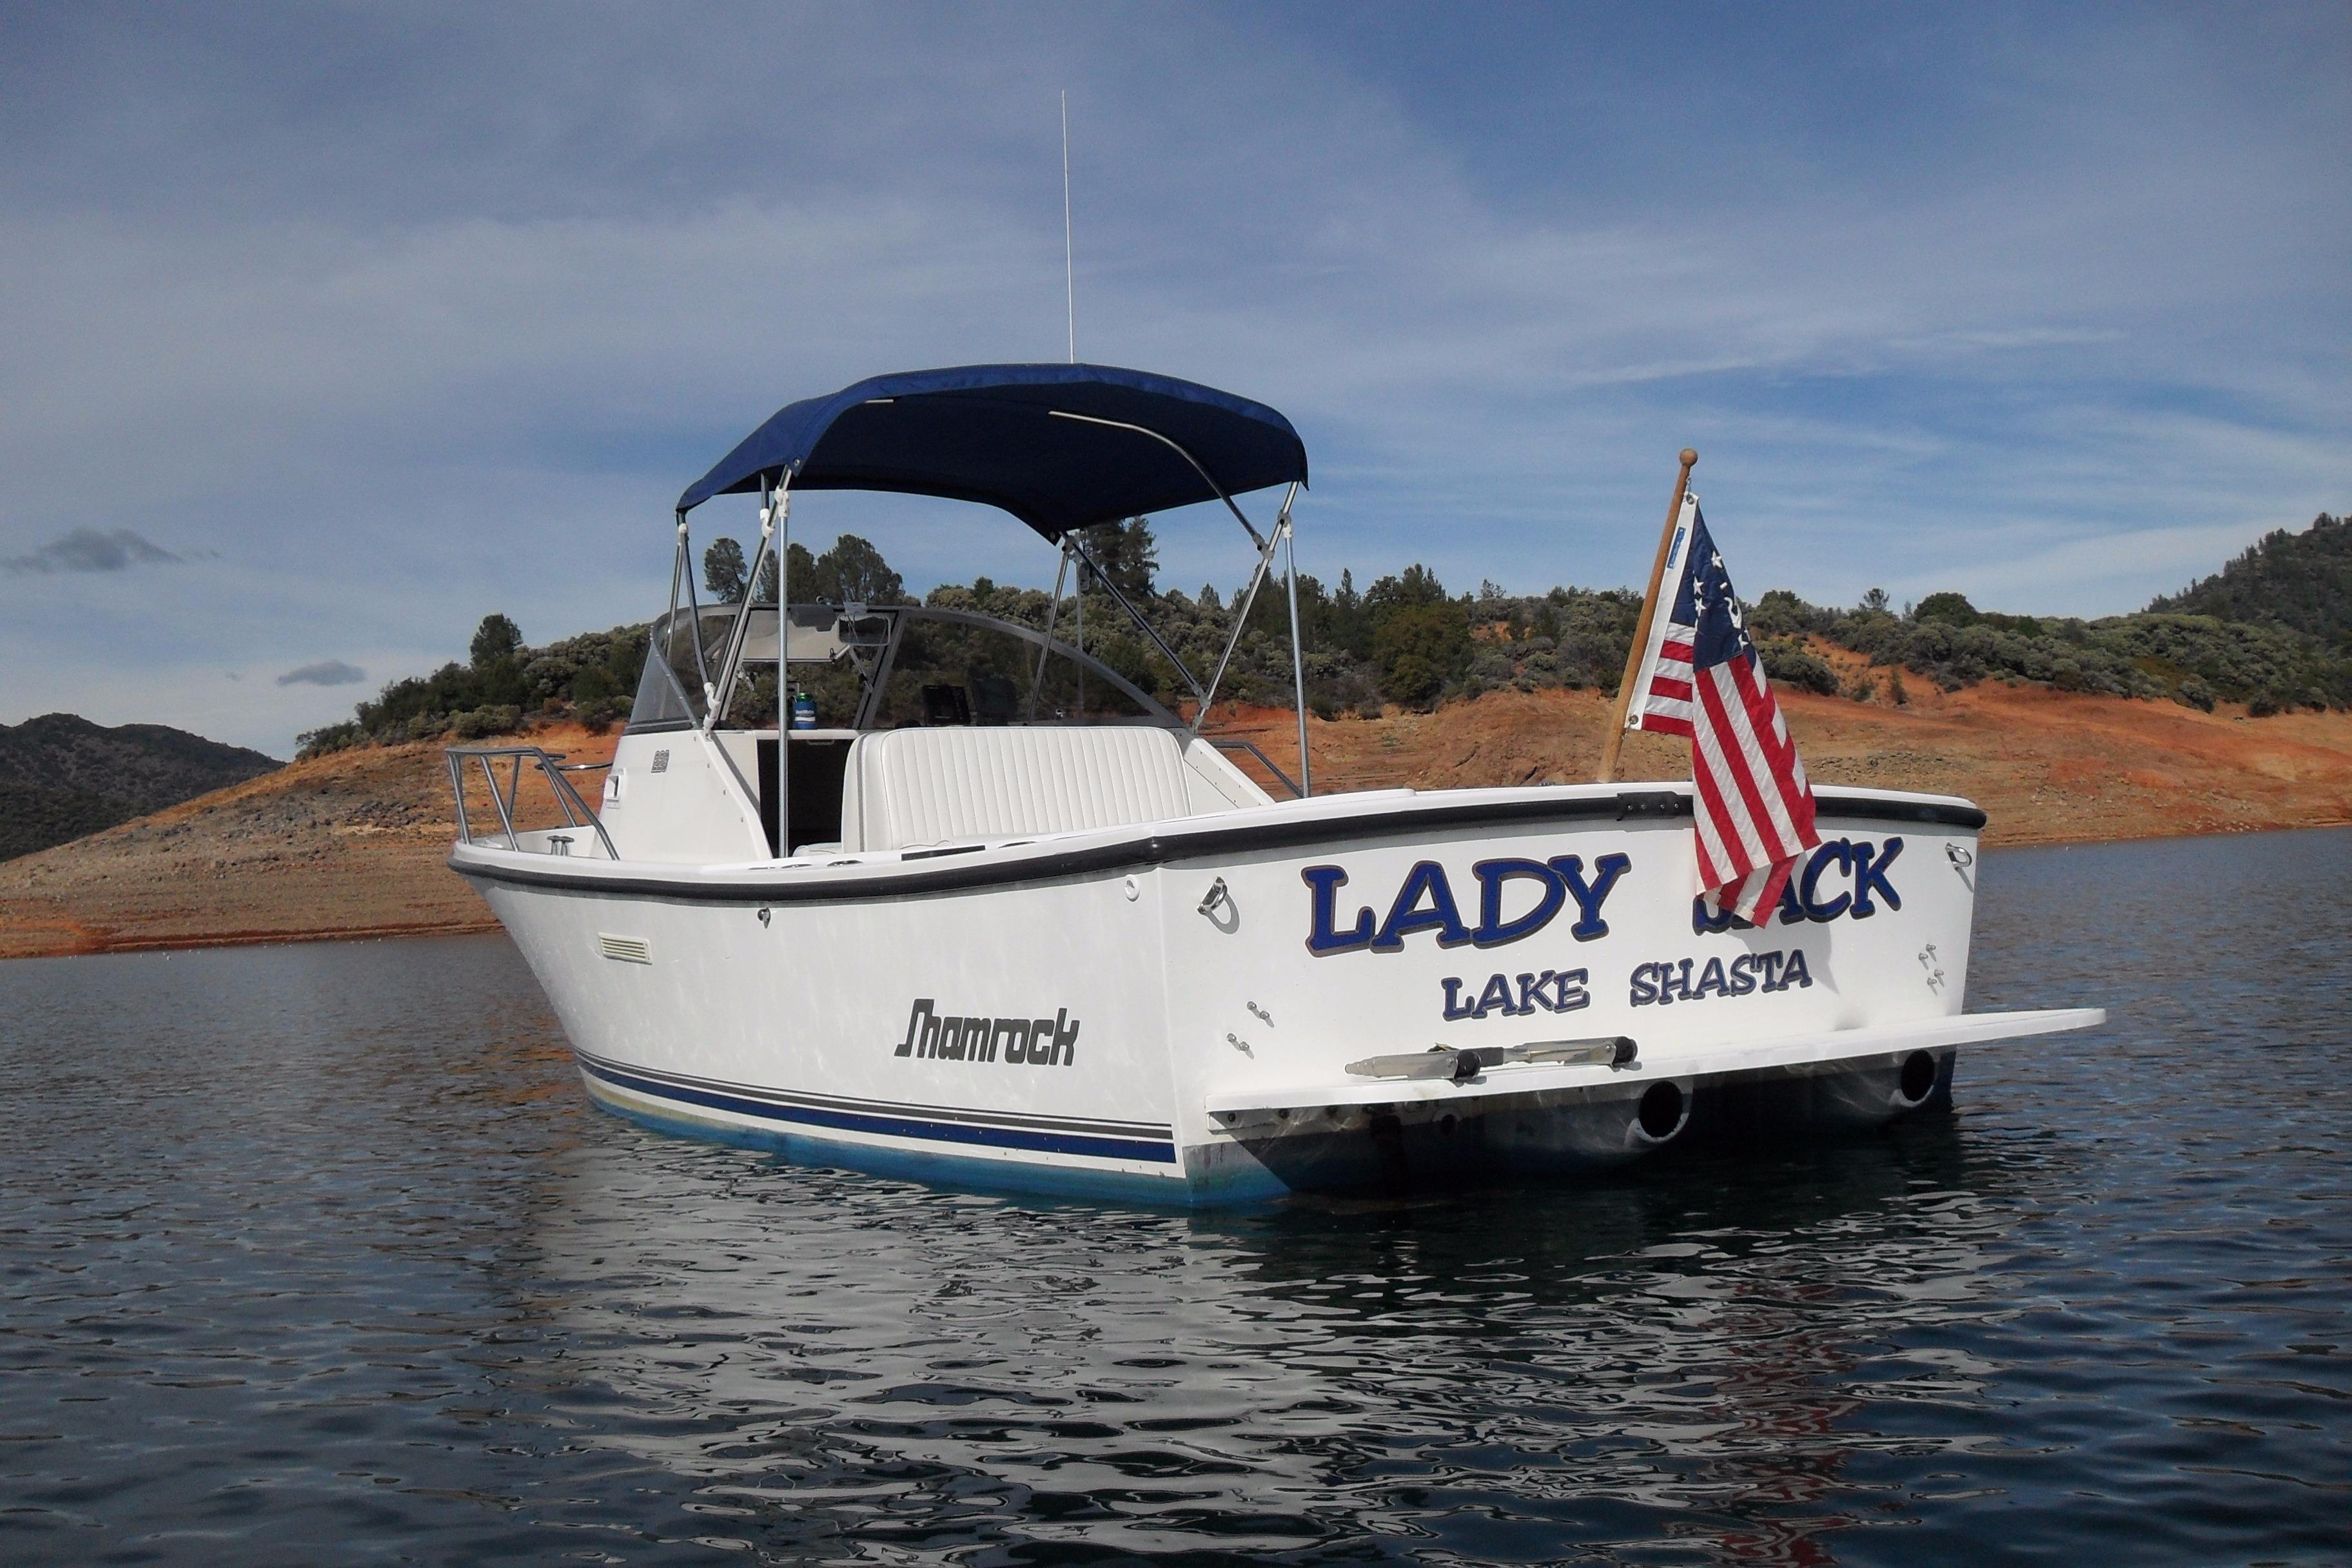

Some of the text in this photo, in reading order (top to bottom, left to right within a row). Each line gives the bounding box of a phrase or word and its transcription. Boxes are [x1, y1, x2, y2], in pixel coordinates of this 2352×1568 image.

[1300, 836, 1905, 958] LADY CK
[1441, 948, 1813, 1021] LAKE SHASTA
[894, 998, 1081, 1066] Shamrock
